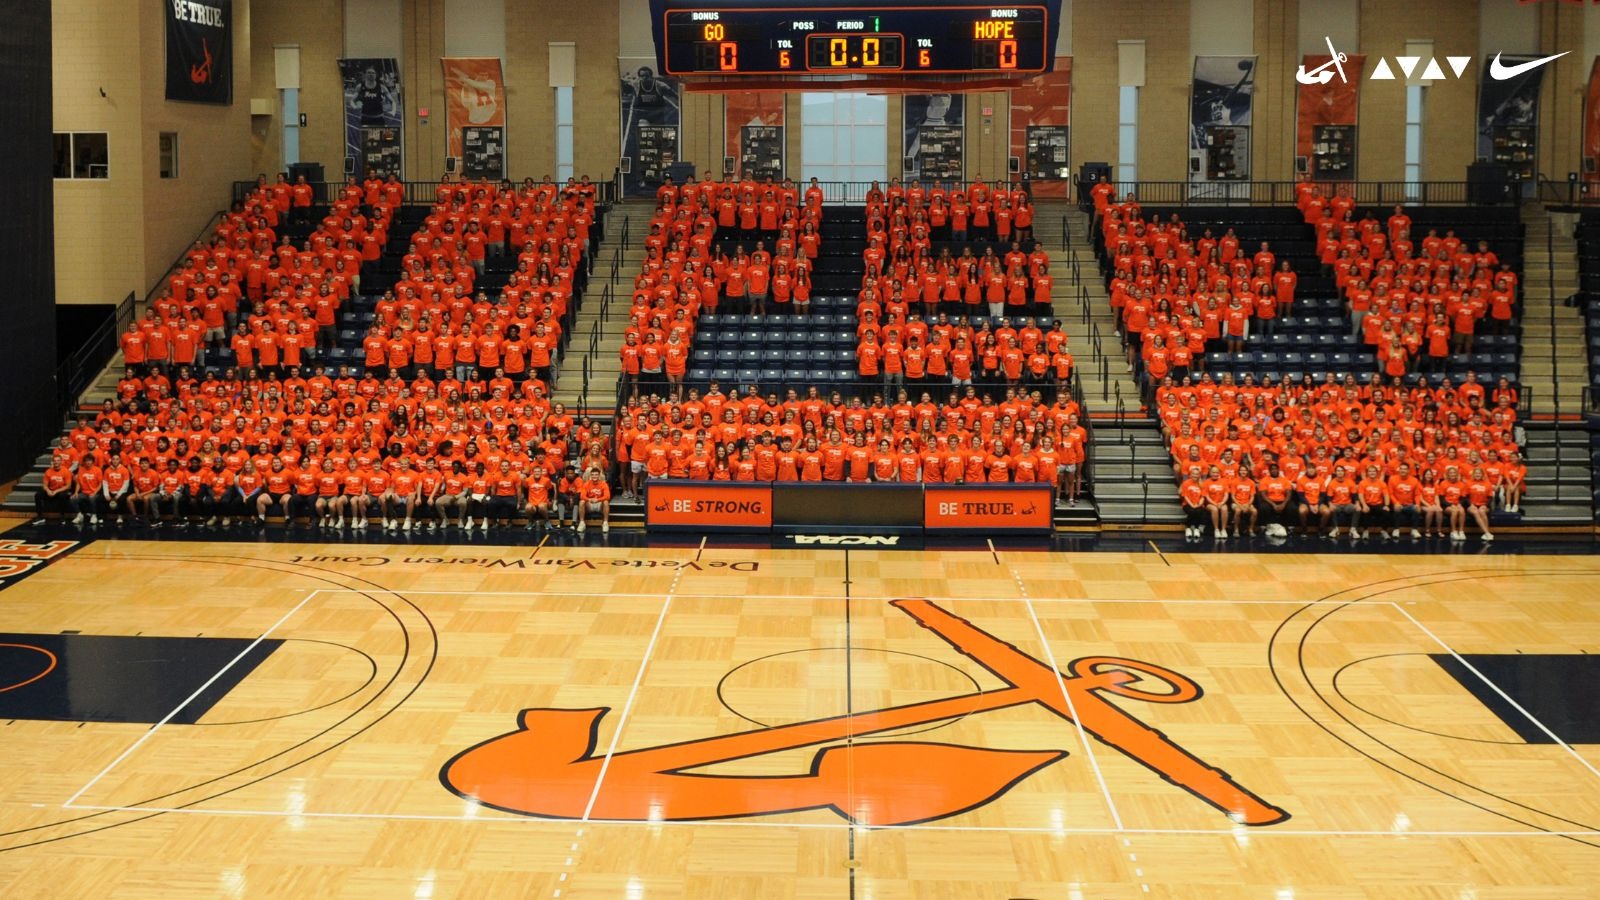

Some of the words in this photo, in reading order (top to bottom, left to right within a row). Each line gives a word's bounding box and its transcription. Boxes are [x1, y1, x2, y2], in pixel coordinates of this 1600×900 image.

[174, 0, 188, 20] BE
[188, 2, 225, 28] TRUE.
[692, 12, 719, 21] BONUS
[991, 9, 1018, 18] BONUS
[704, 24, 724, 41] GO
[793, 22, 814, 30] POSS
[837, 22, 864, 30] PERIOD
[975, 21, 1014, 39] HOPE
[777, 40, 792, 48] TOL
[917, 39, 932, 48] TOL
[720, 43, 737, 70] 0
[780, 51, 790, 67] 6
[919, 51, 930, 67] 6
[1000, 41, 1017, 68] 0
[673, 499, 692, 512] BE
[695, 500, 766, 514] STRONG.
[939, 502, 958, 515] BE
[962, 502, 1017, 515] TRUE.
[795, 535, 899, 545] NCAA
[289, 555, 391, 567] Court
